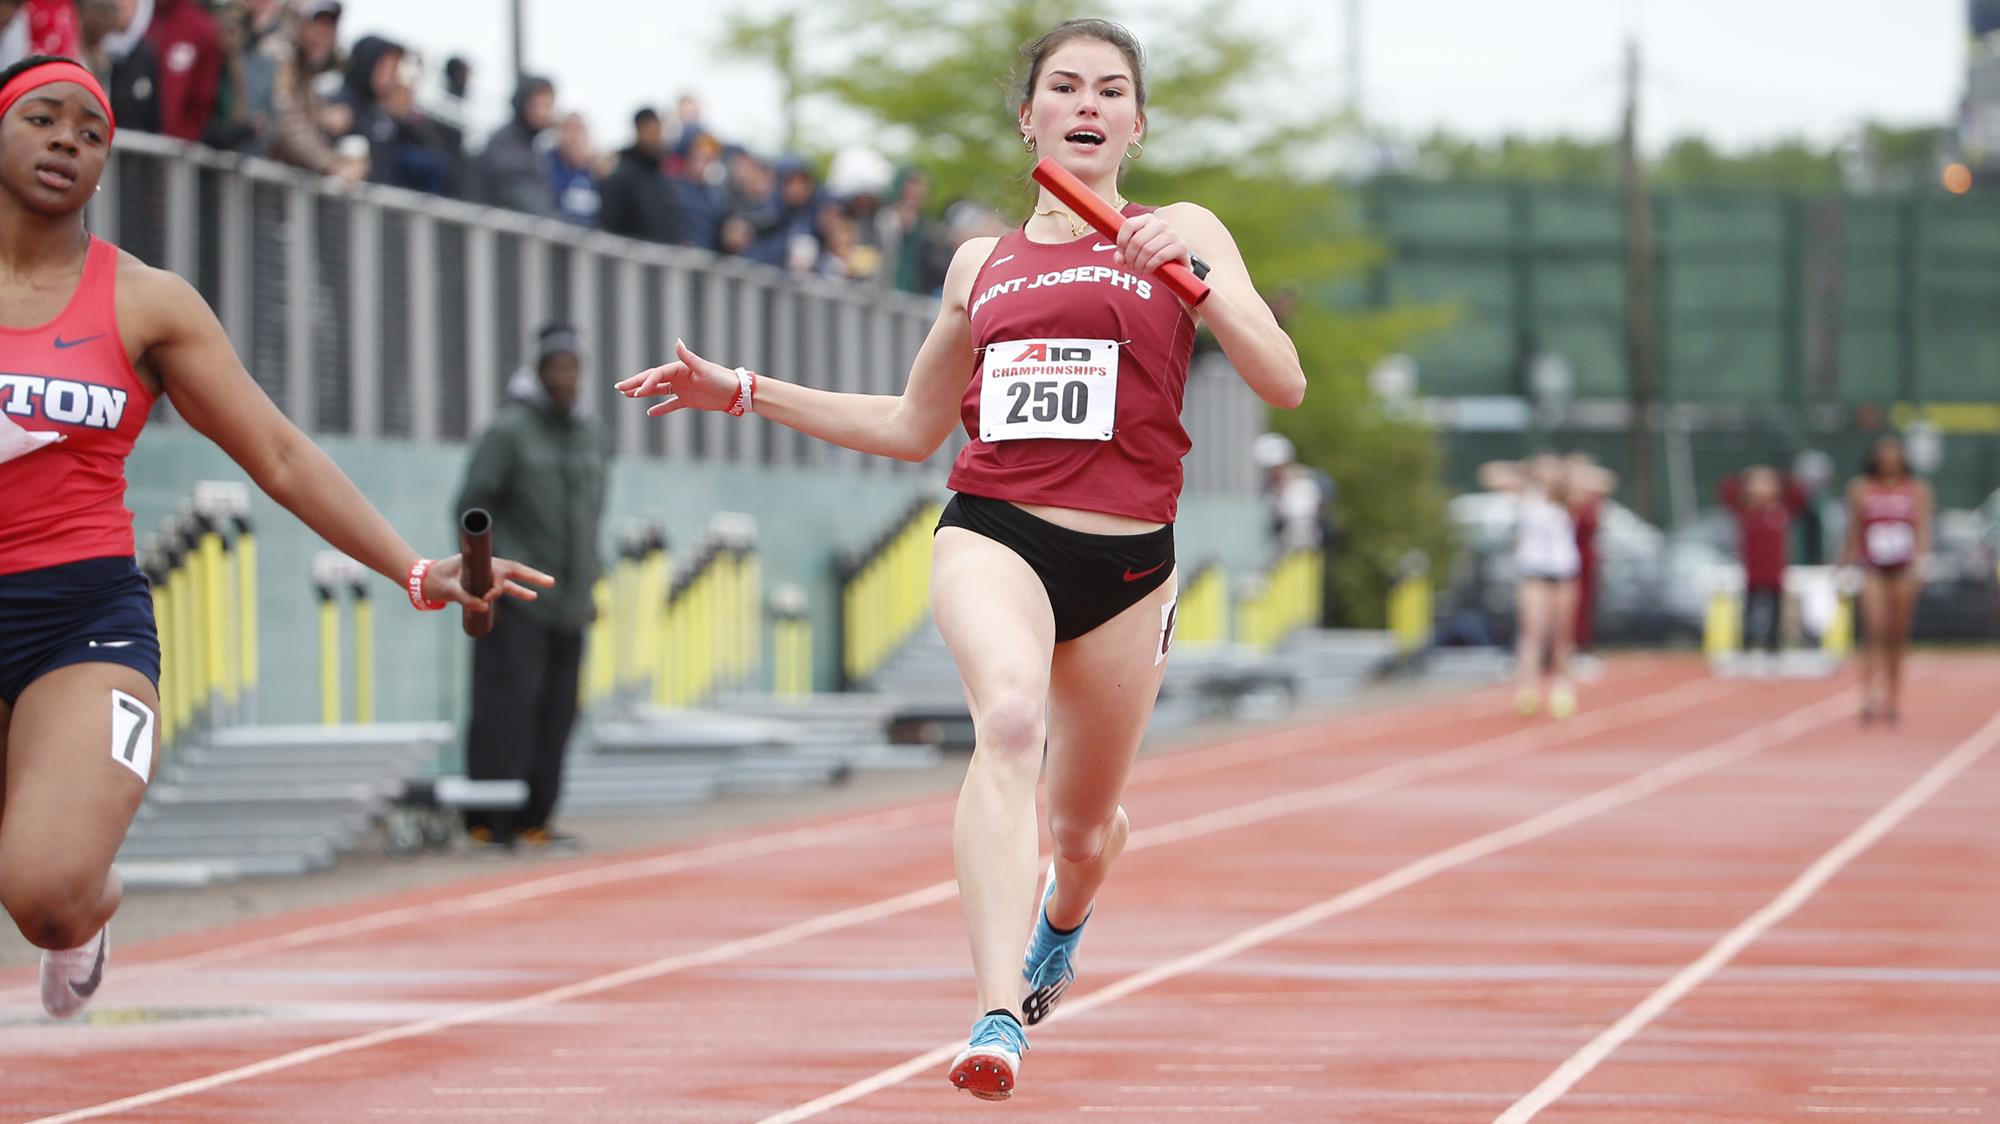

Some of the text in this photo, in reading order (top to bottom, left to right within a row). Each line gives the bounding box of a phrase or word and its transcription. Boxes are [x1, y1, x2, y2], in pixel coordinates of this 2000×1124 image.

[1027, 266, 1152, 300] JOSEPH'S
[992, 365, 1107, 379] CHAMPIONSHIPS
[1011, 343, 1091, 362] A10
[0, 374, 127, 429] TON
[1006, 380, 1089, 424] 250
[119, 698, 148, 763] 7
